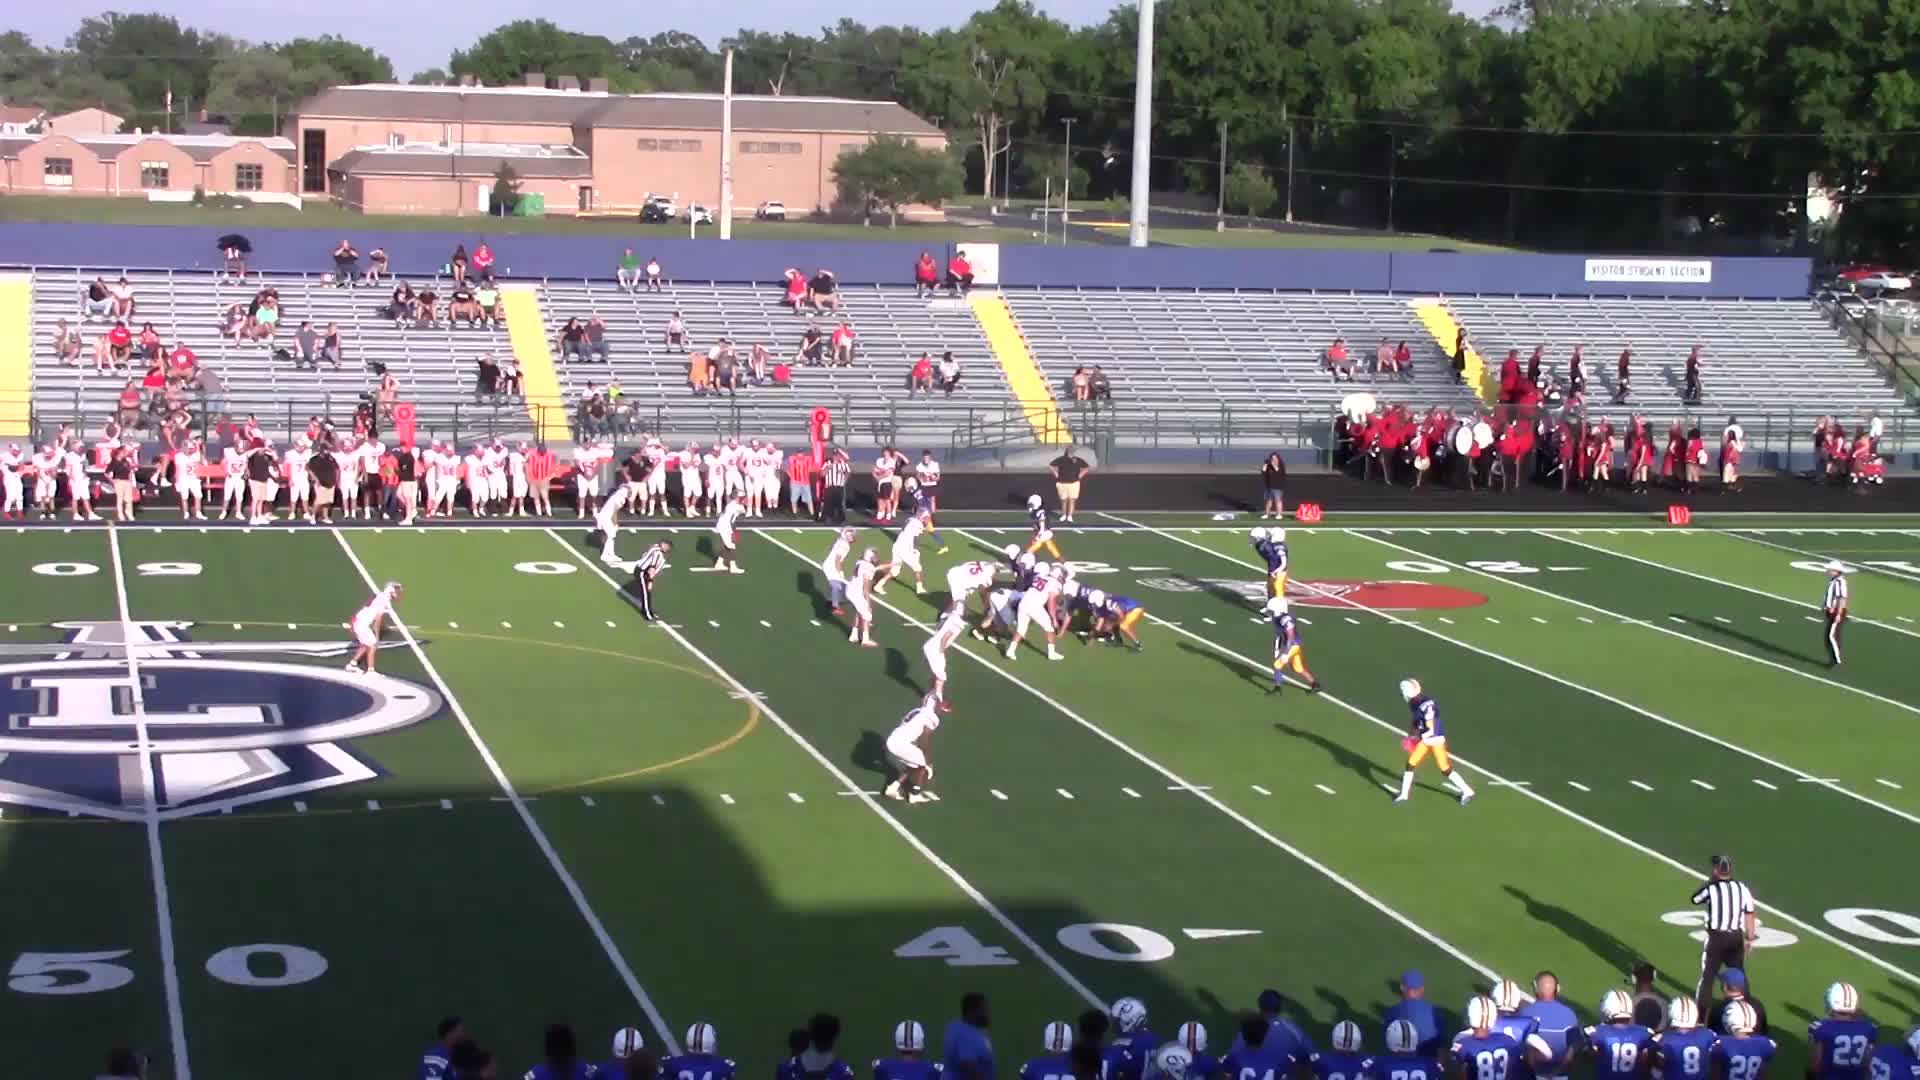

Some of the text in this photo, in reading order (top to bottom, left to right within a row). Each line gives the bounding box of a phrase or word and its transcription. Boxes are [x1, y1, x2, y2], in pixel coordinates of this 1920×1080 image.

[1591, 265, 1706, 278] VISITOR STUDENT SECTION
[1476, 1048, 1509, 1080] 83
[1611, 1042, 1638, 1072] 18
[1683, 1046, 1701, 1075] 8
[1832, 1034, 1868, 1065] 23
[1729, 1055, 1763, 1080] 28
